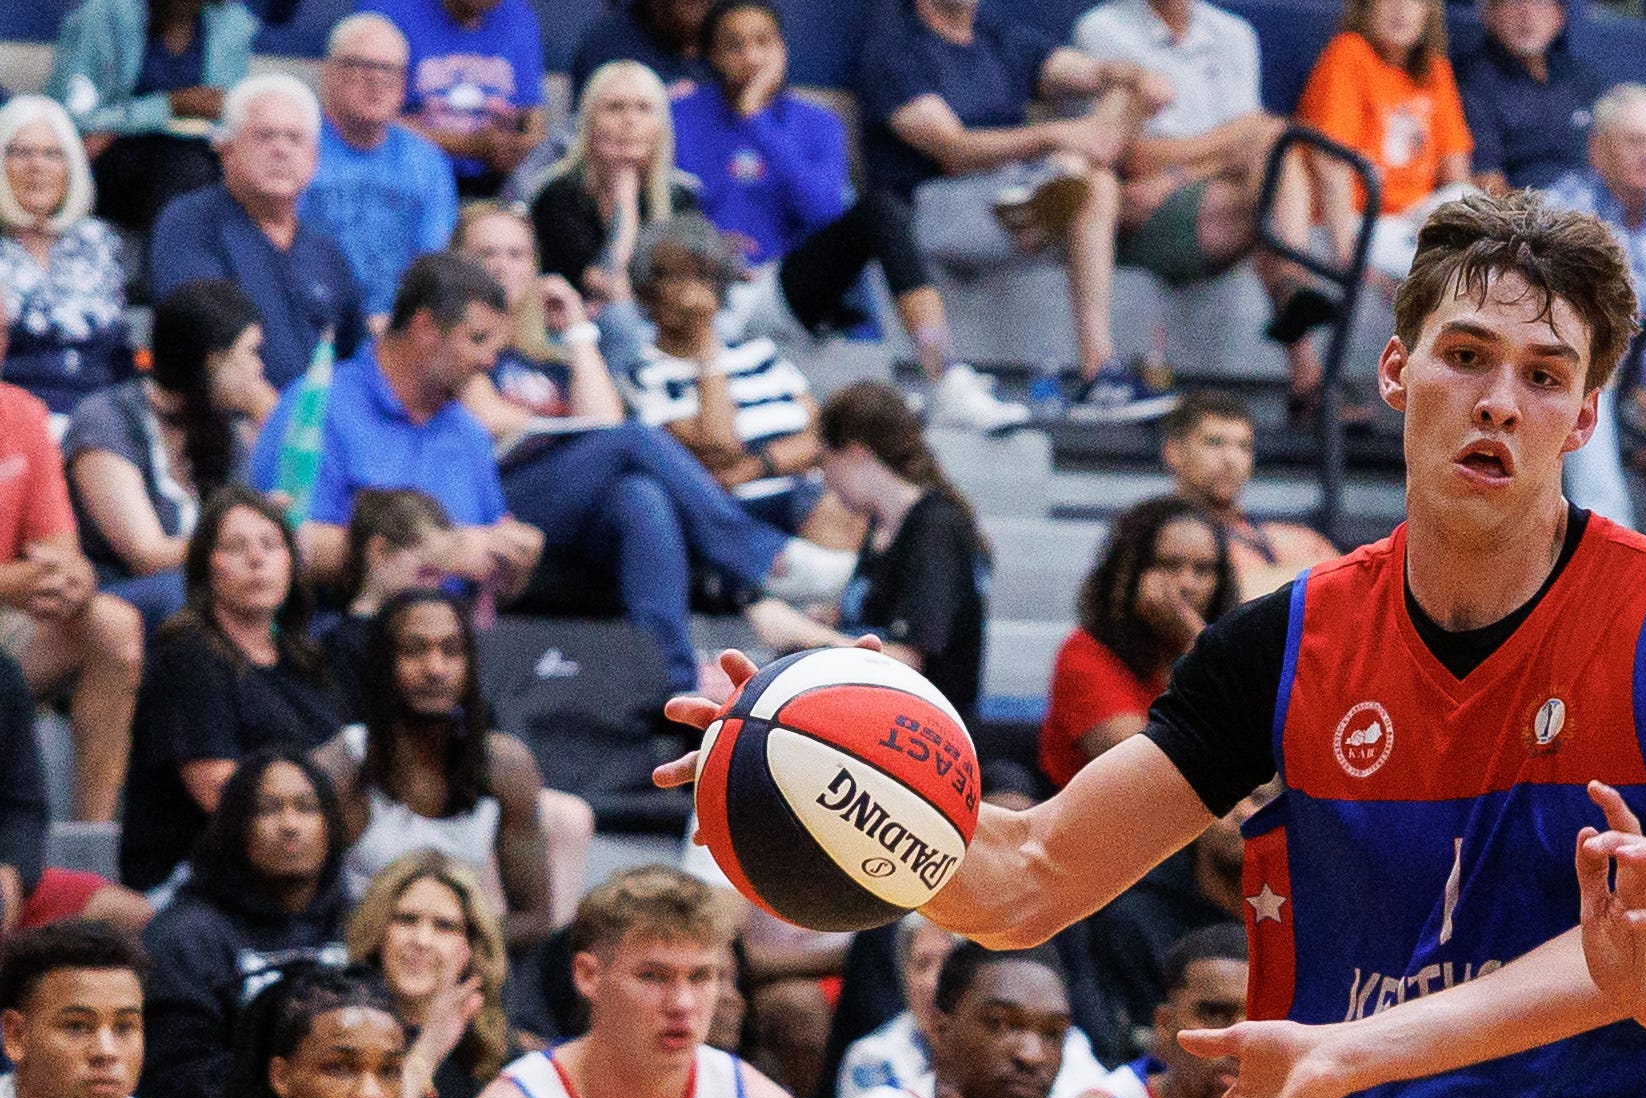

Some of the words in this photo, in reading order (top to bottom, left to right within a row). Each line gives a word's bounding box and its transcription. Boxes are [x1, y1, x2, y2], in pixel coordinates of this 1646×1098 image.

[878, 727, 978, 814] REACT
[815, 767, 958, 891] SPALDING
[1439, 837, 1464, 946] 1
